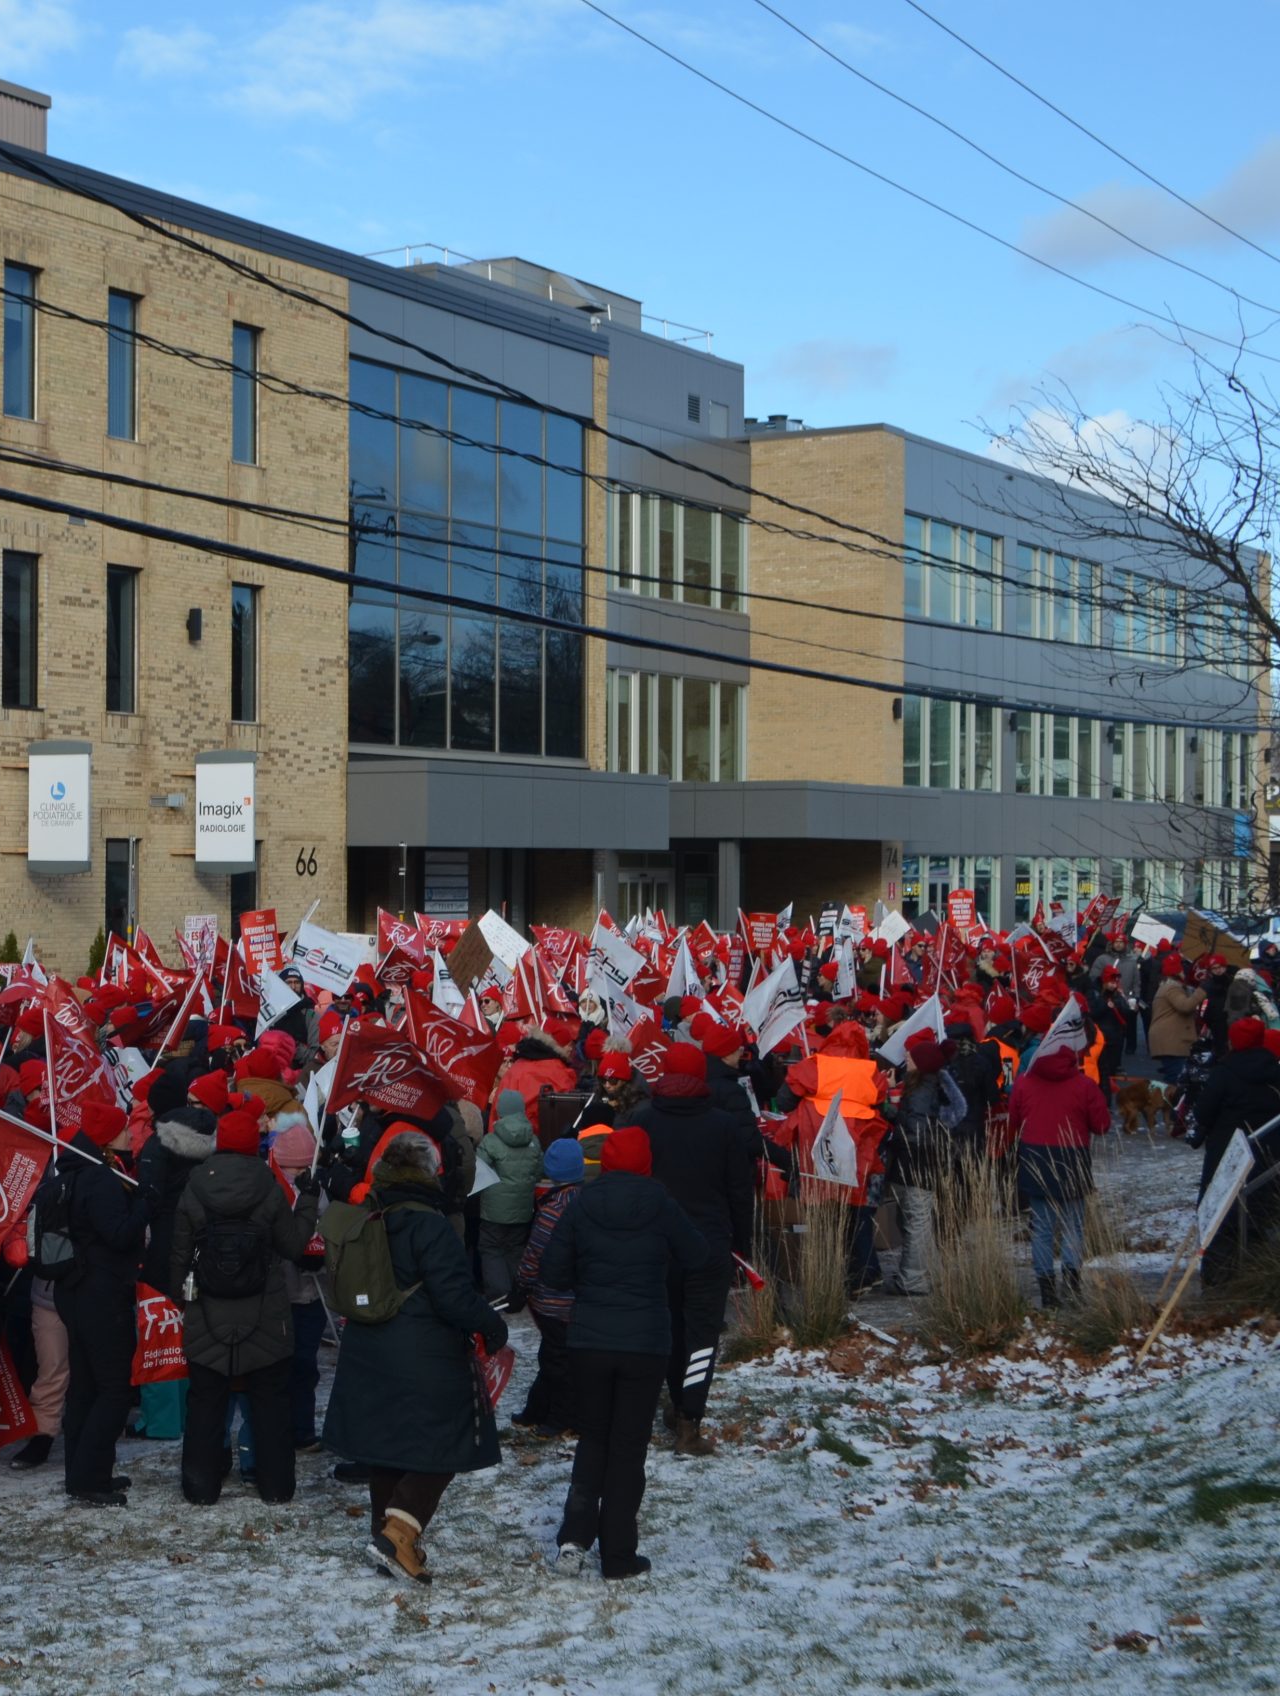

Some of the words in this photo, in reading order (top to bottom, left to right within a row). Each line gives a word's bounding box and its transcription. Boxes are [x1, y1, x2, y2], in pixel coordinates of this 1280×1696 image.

[39, 802, 78, 812] CLINIQUE
[199, 801, 243, 819] Imagix
[32, 811, 84, 820] PODIATRIQUE
[199, 824, 247, 833] RADIOLOGIE
[295, 847, 318, 876] 66
[885, 847, 898, 869] 74
[144, 1347, 183, 1360] Fédératio
[143, 1361, 153, 1369] de
